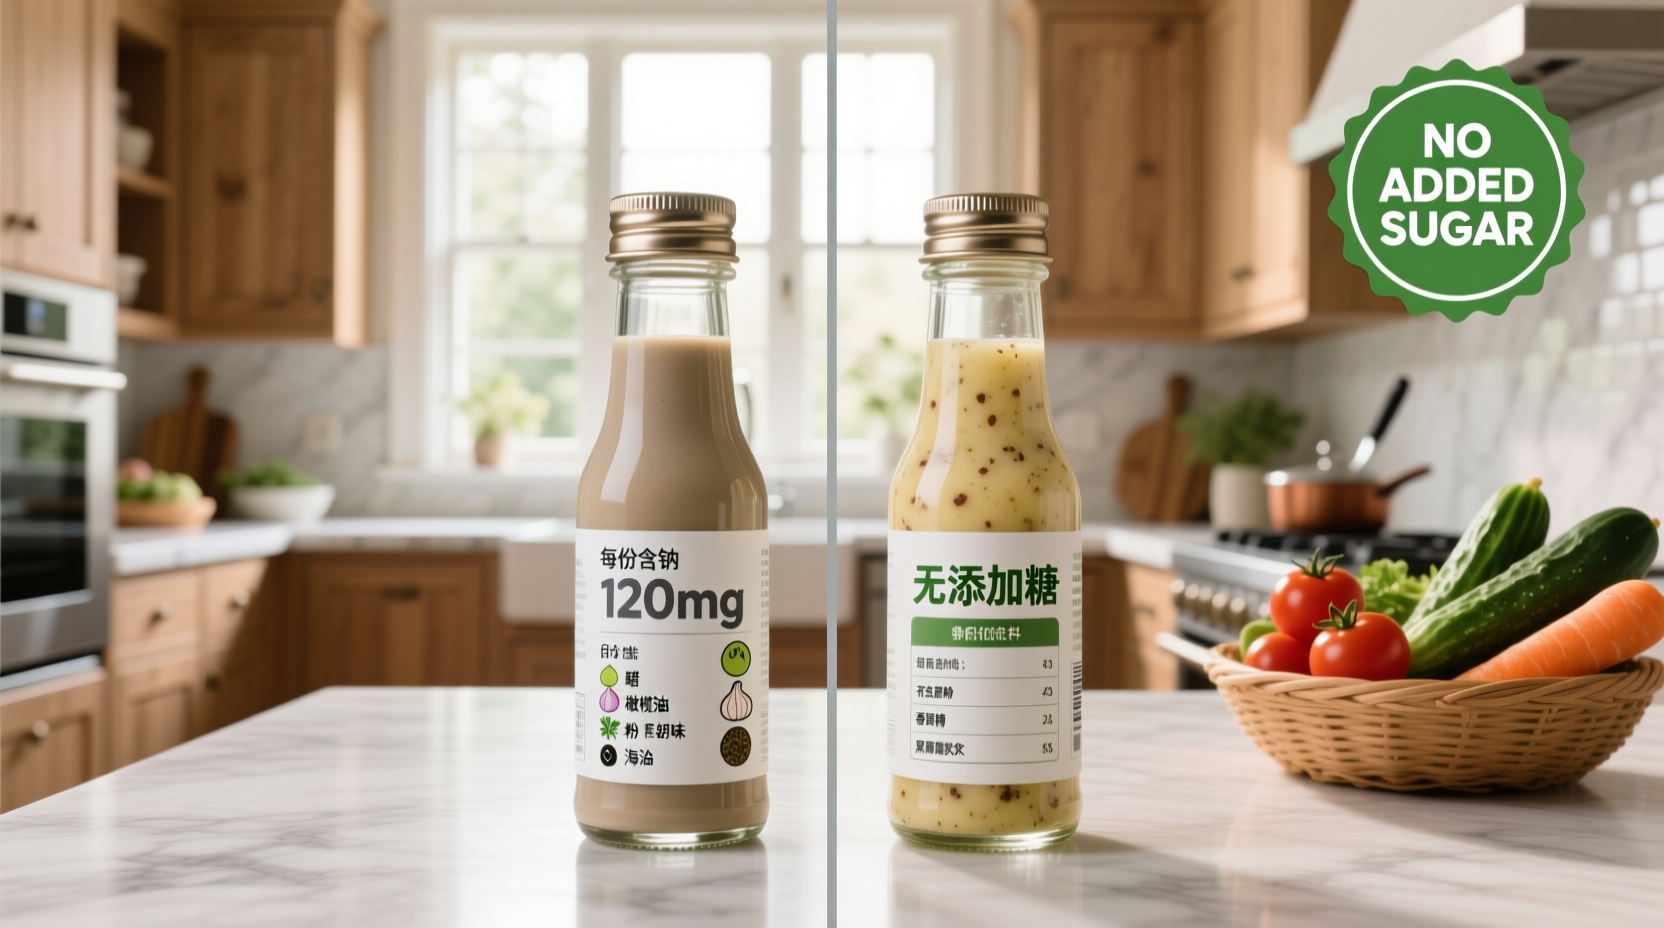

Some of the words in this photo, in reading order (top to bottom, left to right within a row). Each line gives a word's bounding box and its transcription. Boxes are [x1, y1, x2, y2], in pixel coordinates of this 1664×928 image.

[600, 547, 679, 571] 每份含钠
[601, 577, 744, 630] 120mg
[913, 564, 1060, 607] 无添加糖
